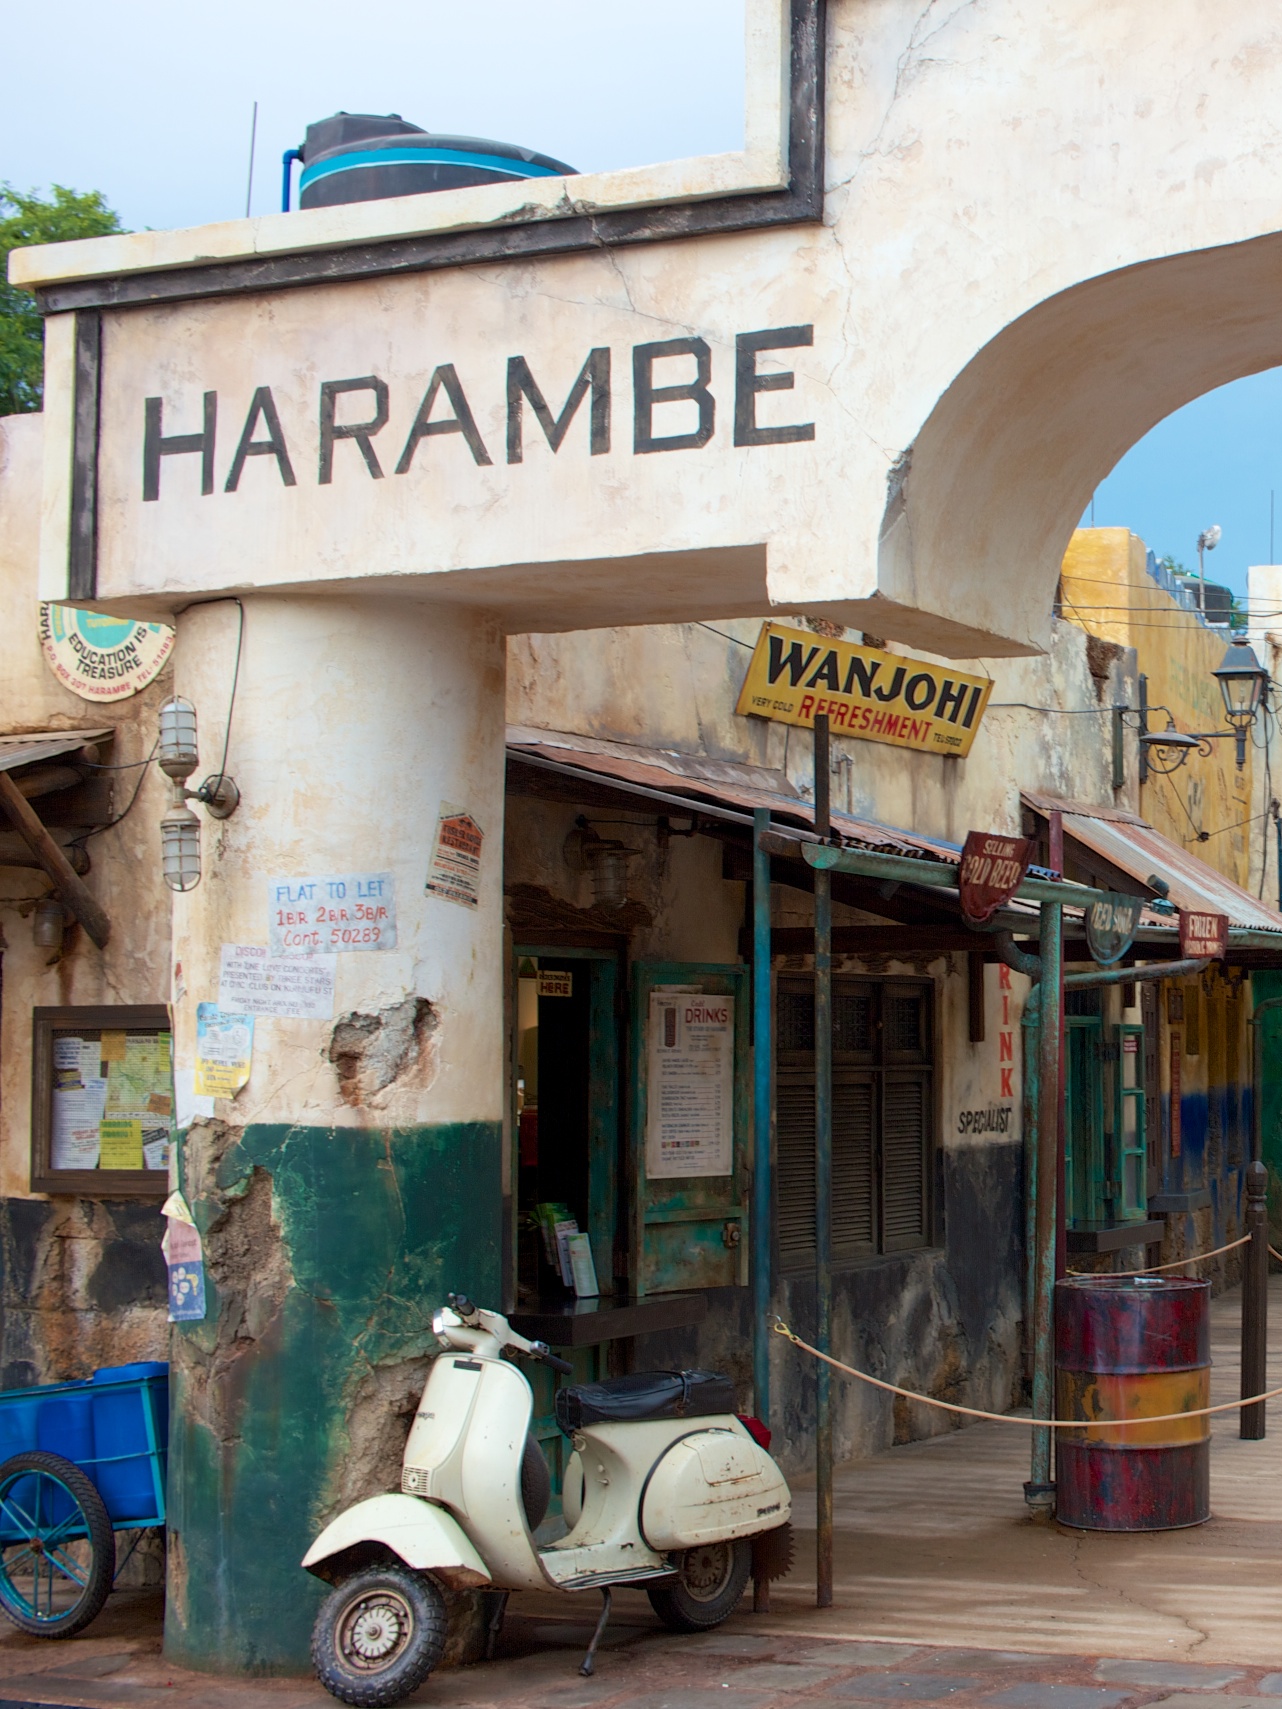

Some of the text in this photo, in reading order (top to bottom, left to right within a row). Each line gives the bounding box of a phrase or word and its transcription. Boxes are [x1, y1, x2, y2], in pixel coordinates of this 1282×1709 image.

[142, 324, 816, 503] HARAMBE
[40, 602, 51, 640] HAR
[68, 626, 147, 666] EDUCATION IS
[56, 663, 71, 680] BOX
[88, 682, 131, 695] HARAMBE
[76, 655, 142, 680] TREASURE
[768, 635, 983, 730] WANJOHI
[752, 696, 771, 709] VERY
[772, 700, 794, 713] COLD
[798, 694, 933, 743] REFRESHMENT
[276, 880, 386, 903] FLAT TO LET
[354, 903, 389, 923] 3B/R
[283, 927, 381, 947] Cont. 50289
[1188, 914, 1218, 938] FROZEN
[222, 970, 332, 985] PRESENTED BY THREE STARS
[270, 984, 281, 992] ON
[322, 987, 333, 995] ST
[540, 981, 569, 995] HERE
[244, 1005, 300, 1015] ENTRANCE FEE
[685, 1007, 728, 1024] DRINKS
[957, 1107, 1013, 1134] SPECIALIST
